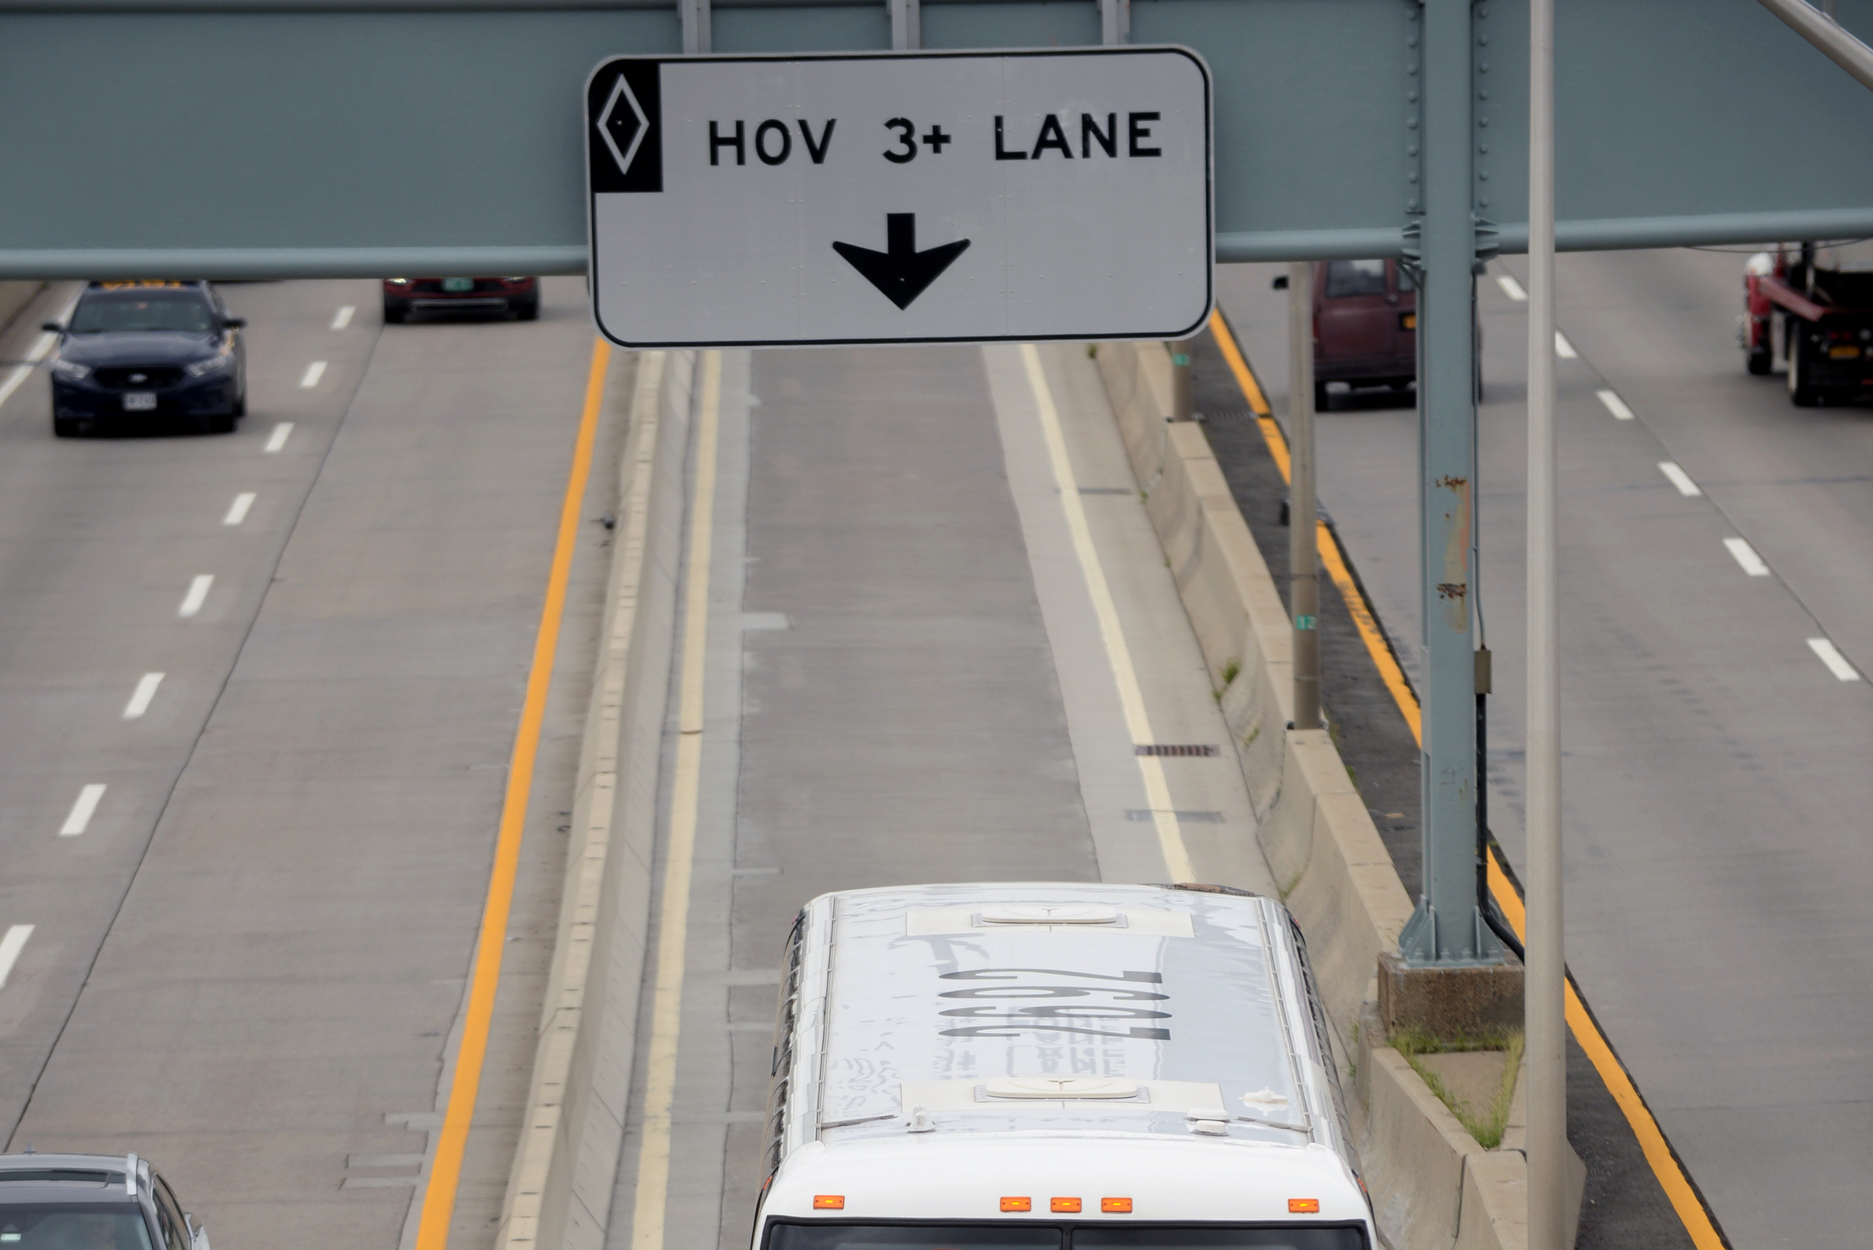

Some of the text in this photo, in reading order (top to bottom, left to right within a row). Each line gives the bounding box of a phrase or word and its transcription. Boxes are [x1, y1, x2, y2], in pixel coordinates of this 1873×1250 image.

[707, 111, 1163, 167] HOV 3+ LANE
